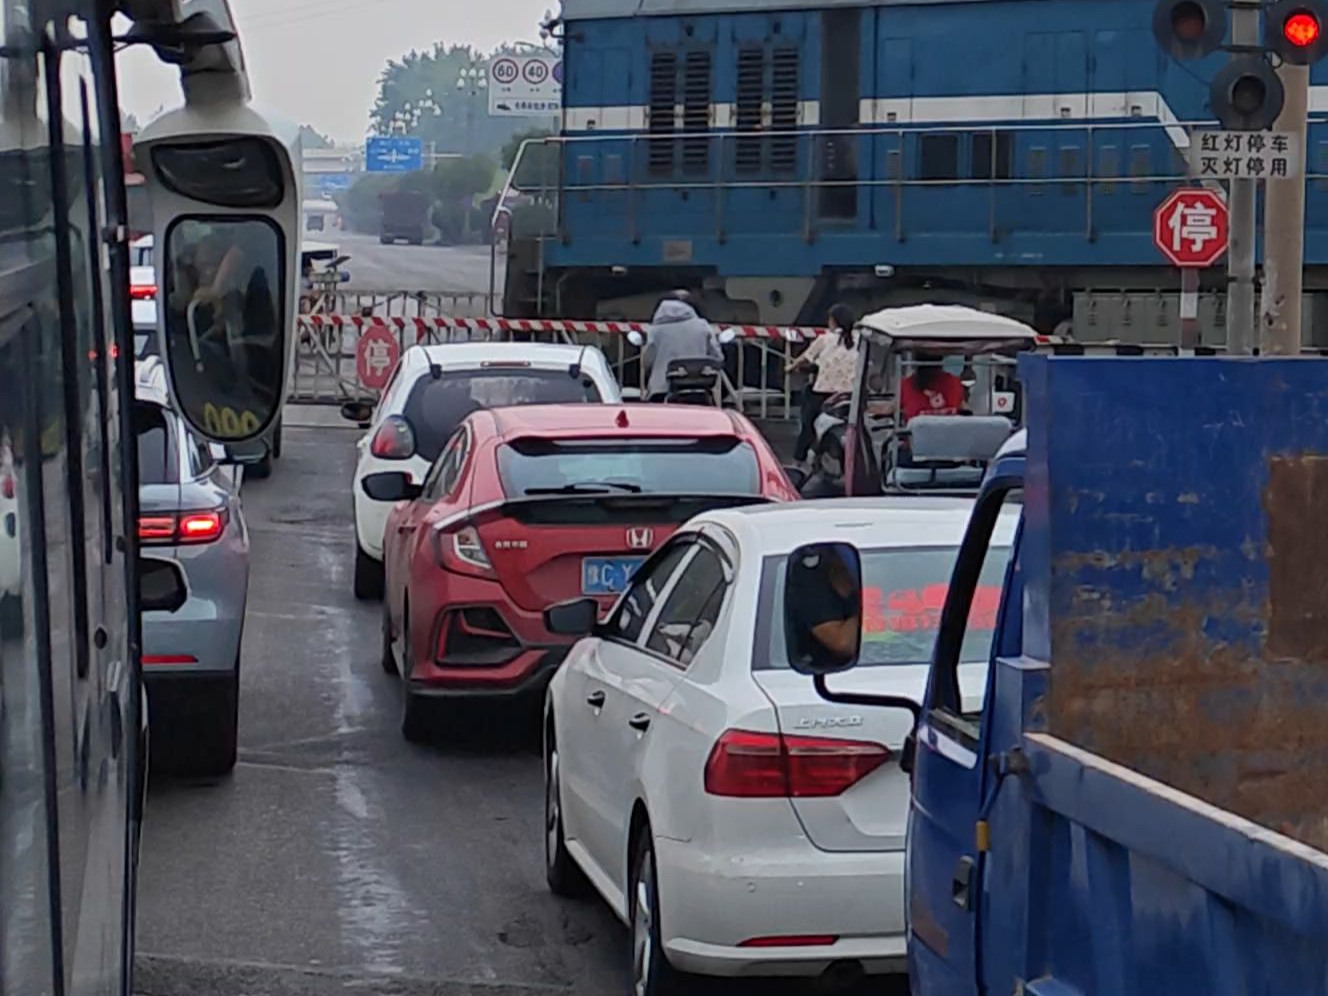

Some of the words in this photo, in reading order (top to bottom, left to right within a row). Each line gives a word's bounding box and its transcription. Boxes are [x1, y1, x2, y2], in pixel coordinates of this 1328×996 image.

[497, 65, 514, 78] 60
[527, 65, 544, 78] 40
[1200, 132, 1289, 154] 红灯停车
[1200, 155, 1288, 177] 灭灯停用
[1168, 200, 1218, 253] 停
[364, 338, 392, 377] 停
